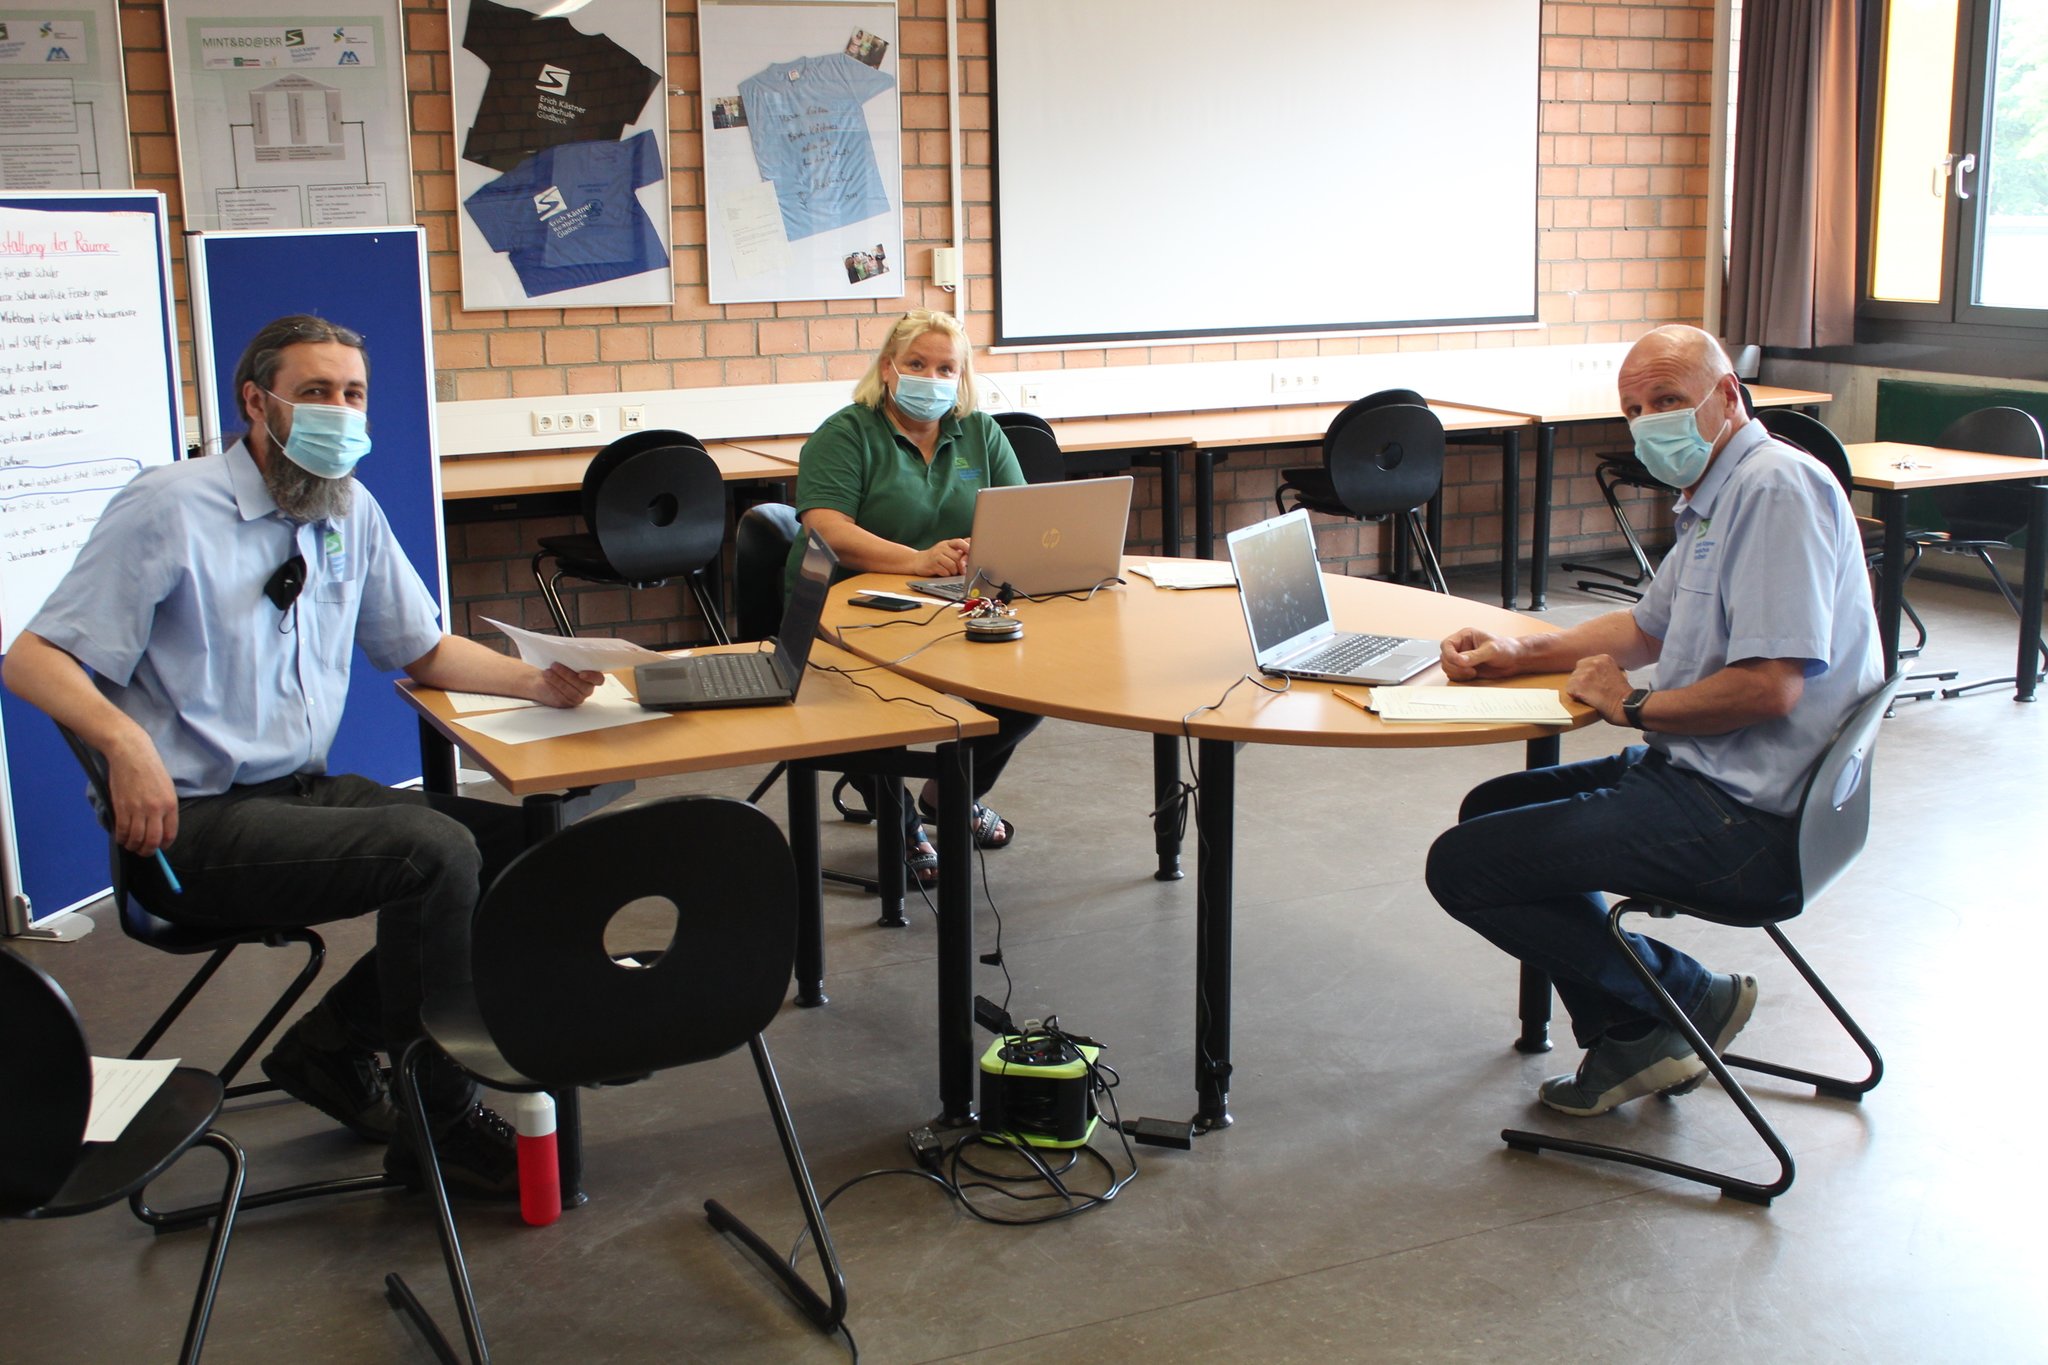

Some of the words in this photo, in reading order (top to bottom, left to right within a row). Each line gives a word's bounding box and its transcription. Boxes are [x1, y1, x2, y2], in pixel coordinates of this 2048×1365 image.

[202, 36, 282, 48] MINT&BO@EKR
[538, 103, 575, 119] Realschule
[540, 95, 557, 106] Erich
[558, 100, 586, 114] Kästner
[536, 110, 567, 125] Gladbeck
[548, 215, 566, 227] Erich
[553, 214, 588, 232] Realschule
[53, 231, 68, 252] der
